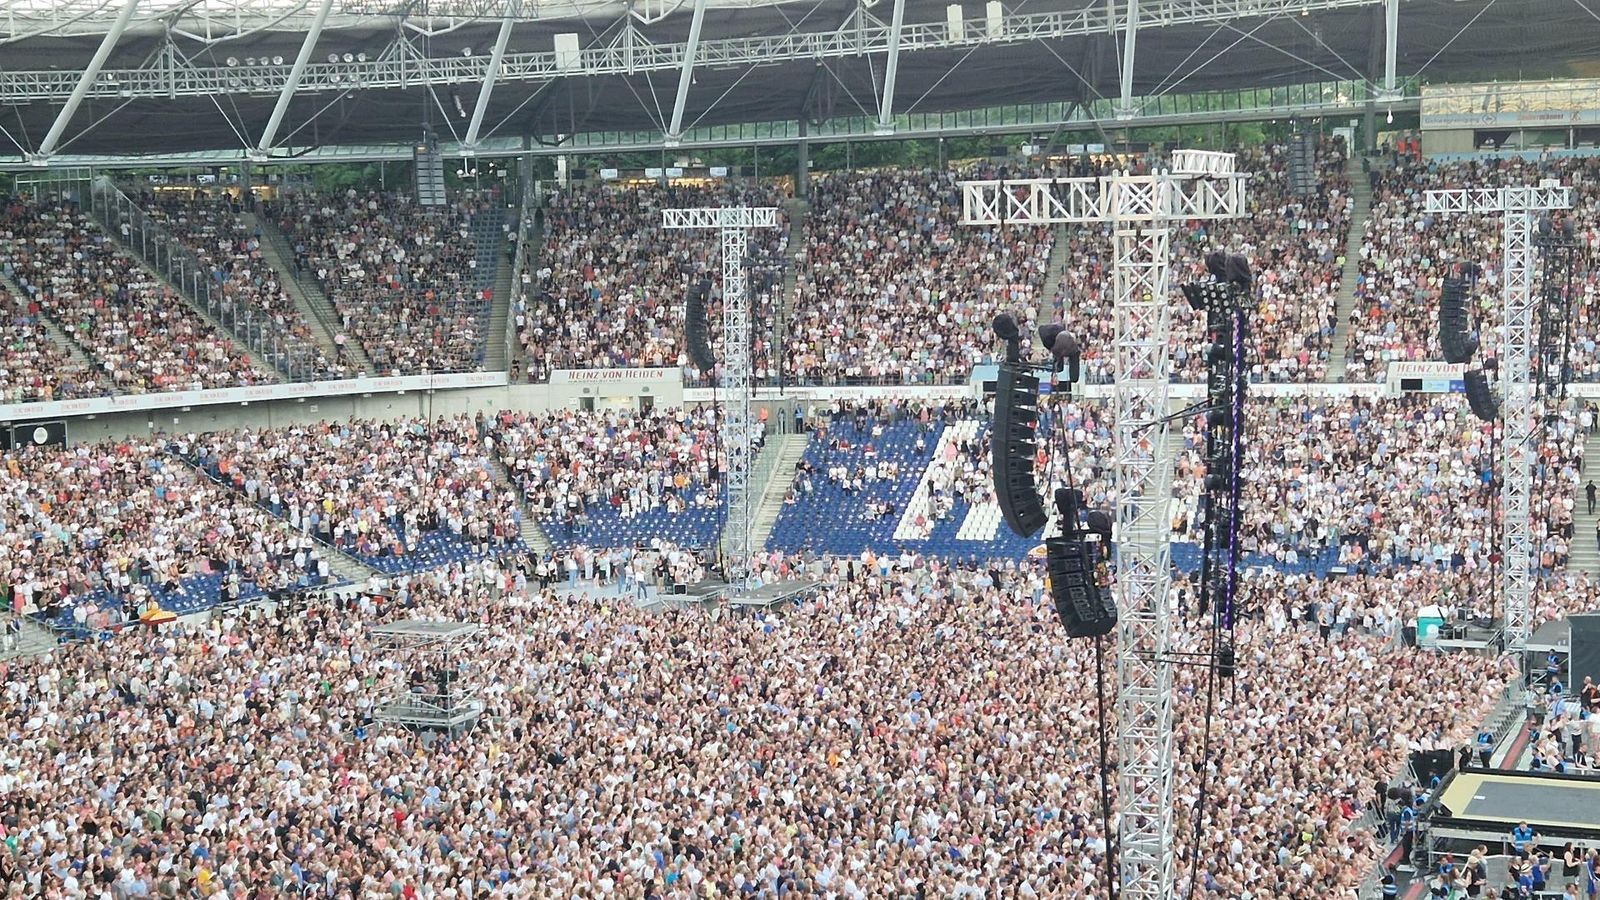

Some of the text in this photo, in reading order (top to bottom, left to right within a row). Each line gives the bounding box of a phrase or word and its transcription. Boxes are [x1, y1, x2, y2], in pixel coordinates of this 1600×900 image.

[1396, 363, 1432, 373] HEINZ
[1436, 364, 1459, 373] VON
[568, 370, 663, 379] HEINZ VON HEIDEN
